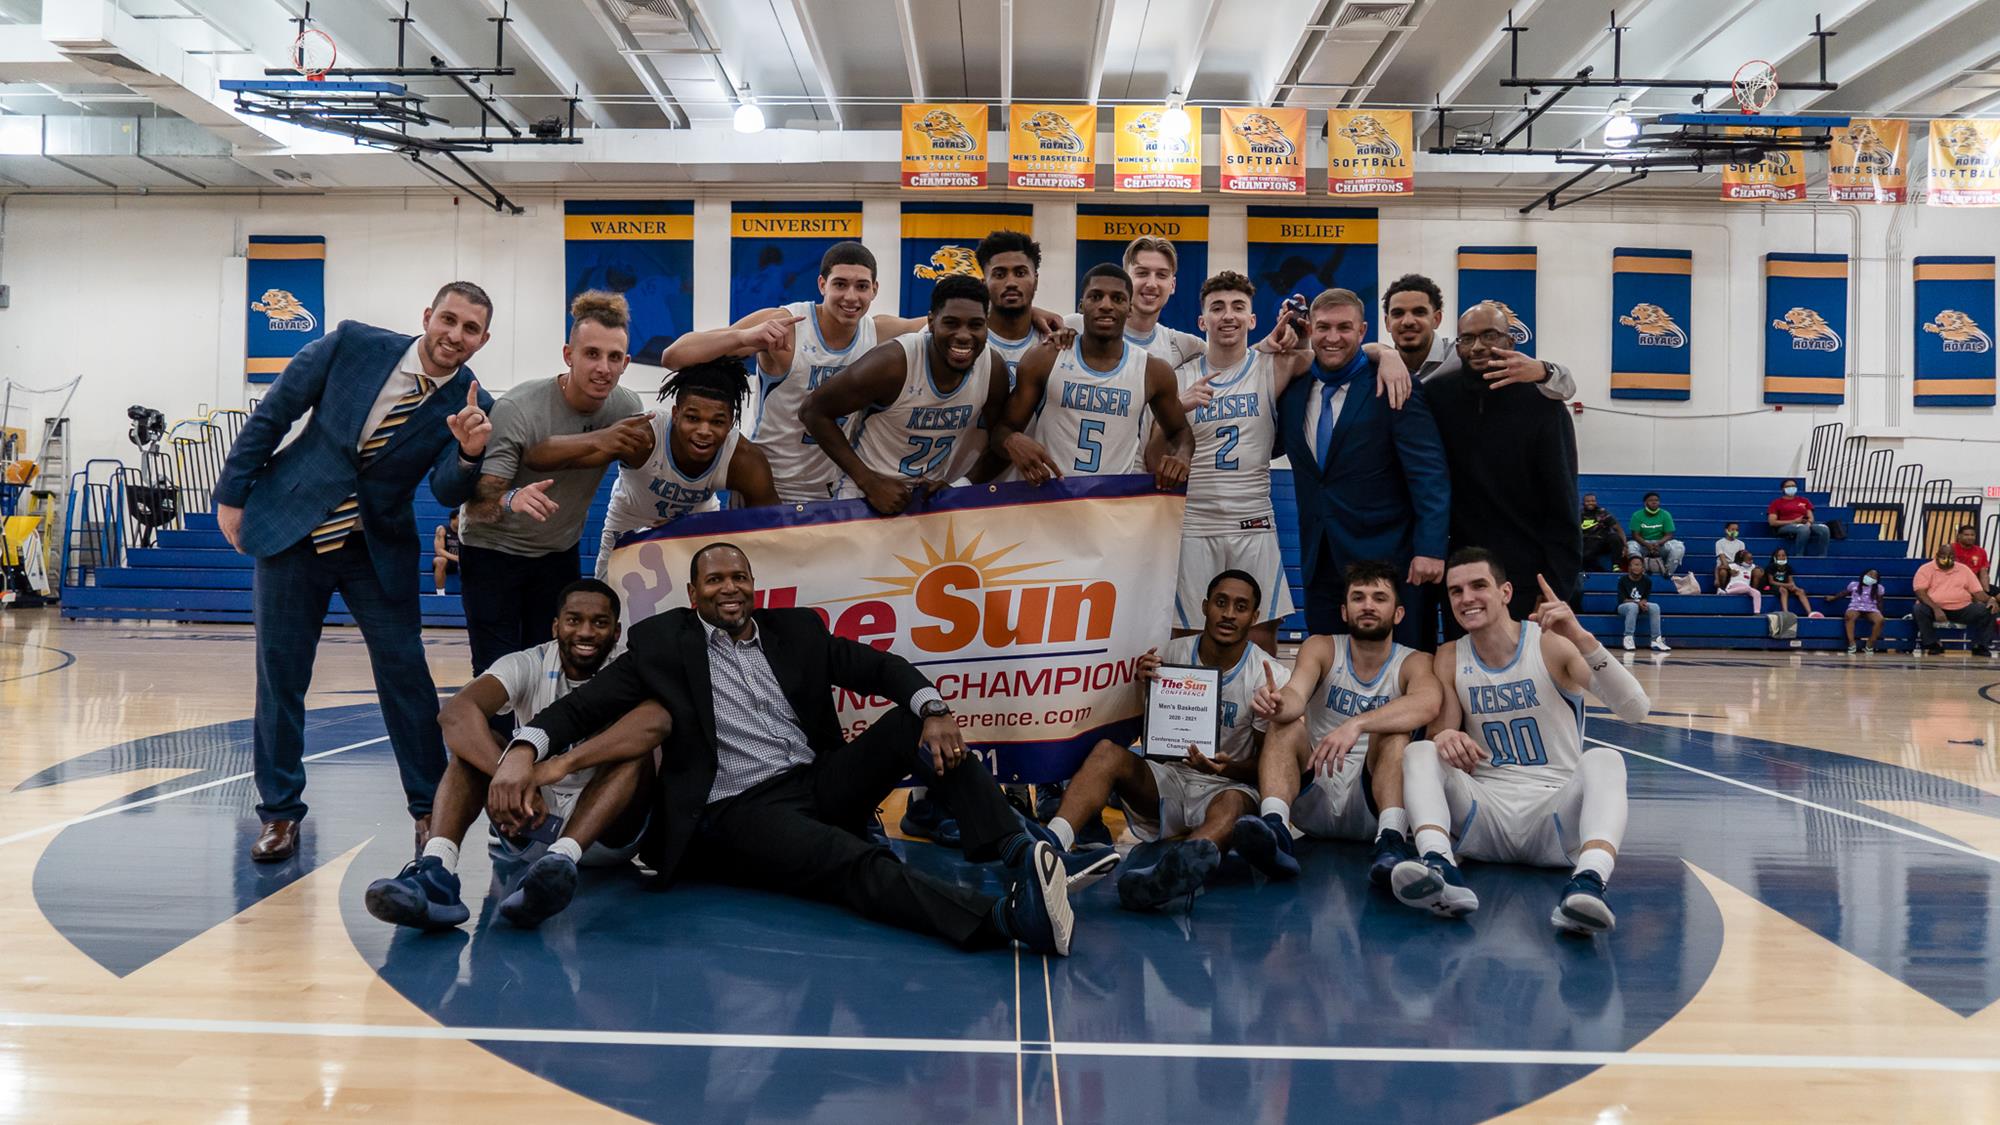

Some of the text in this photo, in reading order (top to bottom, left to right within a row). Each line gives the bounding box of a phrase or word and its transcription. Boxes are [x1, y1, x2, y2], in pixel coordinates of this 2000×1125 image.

[932, 141, 966, 149] ROYALS
[1040, 142, 1074, 150] ROYALS
[1251, 145, 1285, 153] ROYALS
[1357, 147, 1391, 155] ROYALS
[1040, 155, 1091, 163] BASKETBALL
[1227, 155, 1299, 165] SOFTBALL
[1333, 157, 1406, 167] SOFTBALL
[1956, 158, 1990, 166] ROYAL
[1730, 163, 1797, 176] SOFTBALL
[1866, 166, 1901, 176] SCCER
[1931, 169, 2000, 178] SOFTBAL
[910, 176, 979, 186] CHAMPIONS
[1017, 176, 1086, 188] CHAMPIONS
[1123, 178, 1192, 188] CHAMPIONS
[1229, 179, 1296, 191] CHAMPIONS
[1335, 182, 1403, 192] CHAMPIONS
[1730, 187, 1796, 199] CHAMPIONS
[1831, 189, 1897, 202] CHAMPNS
[591, 221, 667, 235] WARNER
[741, 218, 852, 233] UNIVERSITY
[1104, 222, 1181, 236] BEYOND
[1281, 224, 1345, 238] BELIEF
[269, 320, 310, 330] ROYALS
[1639, 335, 1681, 346] ROYALS
[1793, 340, 1835, 350] ROYALS
[1944, 342, 1985, 352] ROYALS
[1061, 381, 1132, 417] KEISER
[1194, 392, 1260, 424] KEISER
[906, 404, 973, 430] KEISER
[1074, 418, 1105, 473] 5
[1215, 425, 1240, 470] 2
[898, 435, 956, 478] 22
[648, 477, 711, 504] KEISER
[911, 565, 1117, 653] Sun
[1161, 678, 1208, 691] The Sun
[1468, 678, 1540, 714] KEISER
[1177, 704, 1208, 712] Basketball
[1150, 735, 1180, 743] Conference
[1482, 717, 1549, 768] 00
